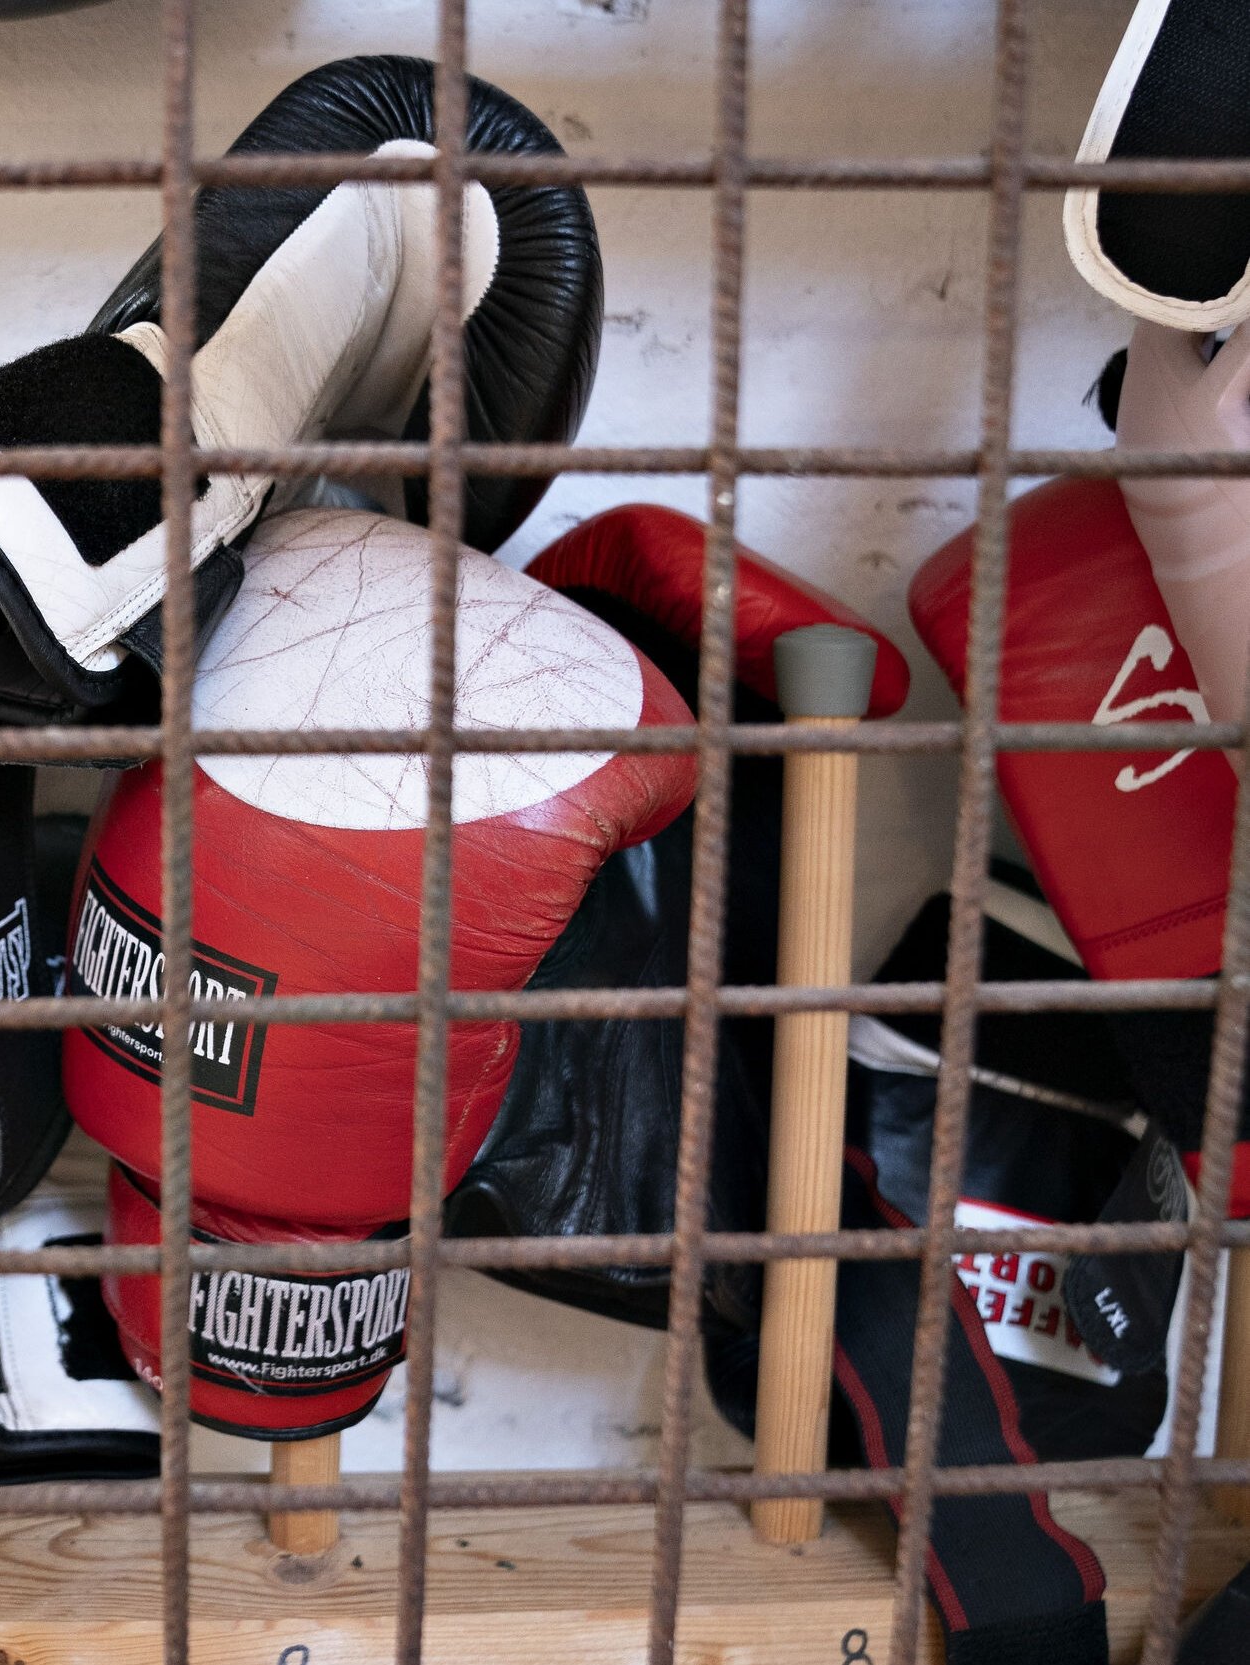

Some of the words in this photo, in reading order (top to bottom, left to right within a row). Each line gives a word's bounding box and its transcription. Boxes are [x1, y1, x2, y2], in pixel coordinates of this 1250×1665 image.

[187, 1266, 411, 1359] FIGHTERSPORT
[1094, 1286, 1130, 1339] L/XL
[207, 1347, 388, 1381] www.Fightersport.dk
